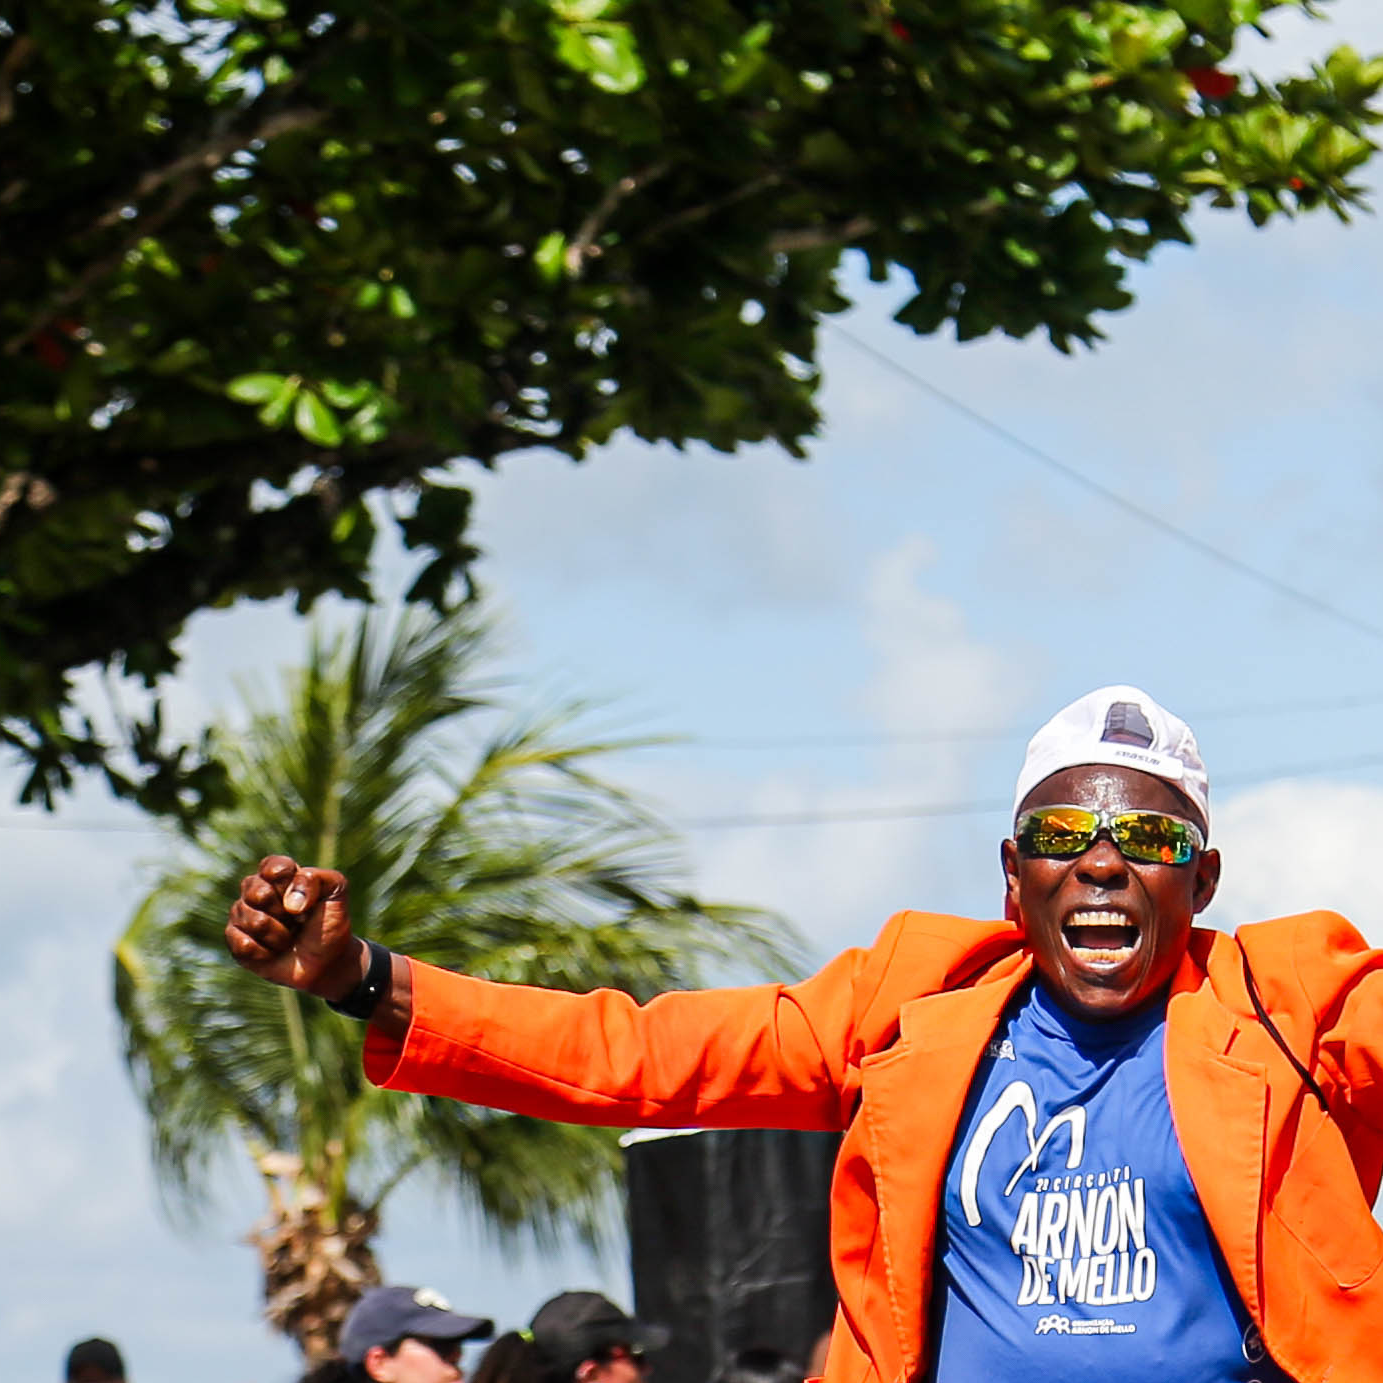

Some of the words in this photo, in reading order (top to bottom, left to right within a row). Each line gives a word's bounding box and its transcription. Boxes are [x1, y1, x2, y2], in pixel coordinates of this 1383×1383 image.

[1010, 1177, 1146, 1260] ARNON
[1017, 1255, 1056, 1306] DE
[1057, 1247, 1157, 1306] MELLO
